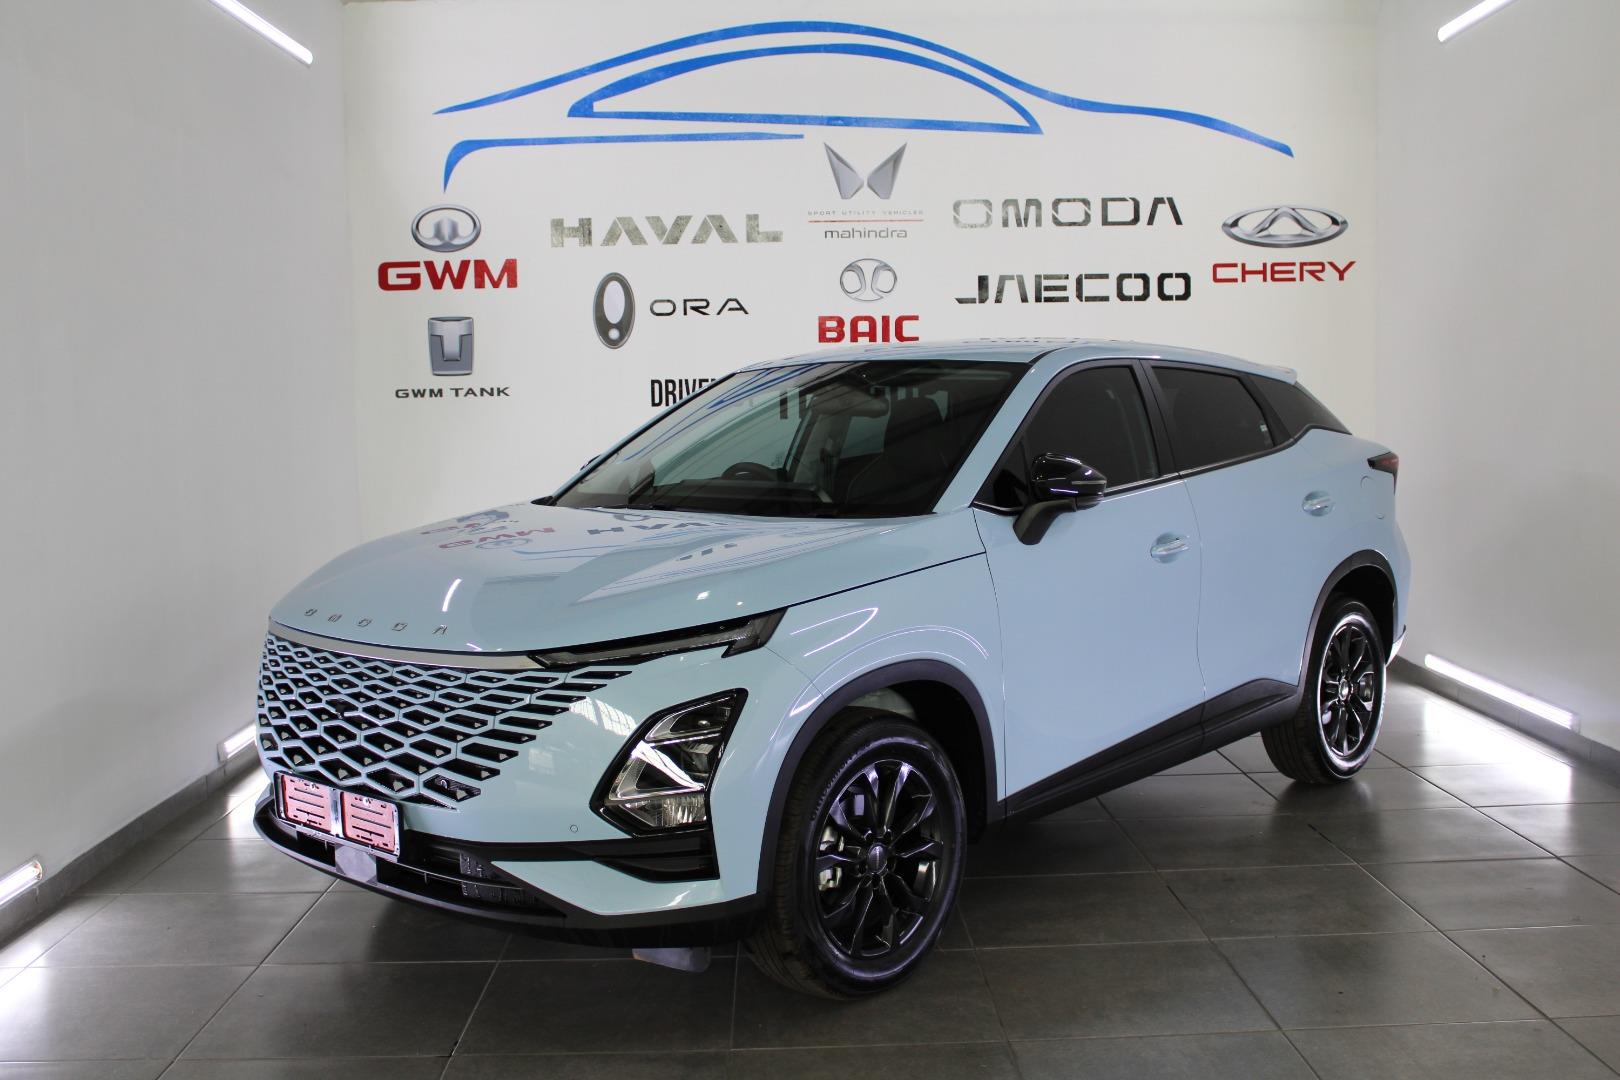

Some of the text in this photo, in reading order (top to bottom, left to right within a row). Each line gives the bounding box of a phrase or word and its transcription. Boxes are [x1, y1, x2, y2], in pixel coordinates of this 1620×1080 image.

[807, 209, 836, 217] SPORT
[882, 208, 924, 216] VEHICLES
[953, 196, 1184, 229] OMODA
[550, 213, 783, 248] HAVAL
[824, 227, 908, 239] mahindra
[377, 258, 518, 291] GWM
[1212, 261, 1356, 284] CHERY
[954, 273, 1192, 304] JAECOO
[649, 298, 749, 317] ORA
[817, 315, 920, 343] BAIC
[394, 386, 511, 399] GWM TANK
[650, 378, 717, 407] DRIV
